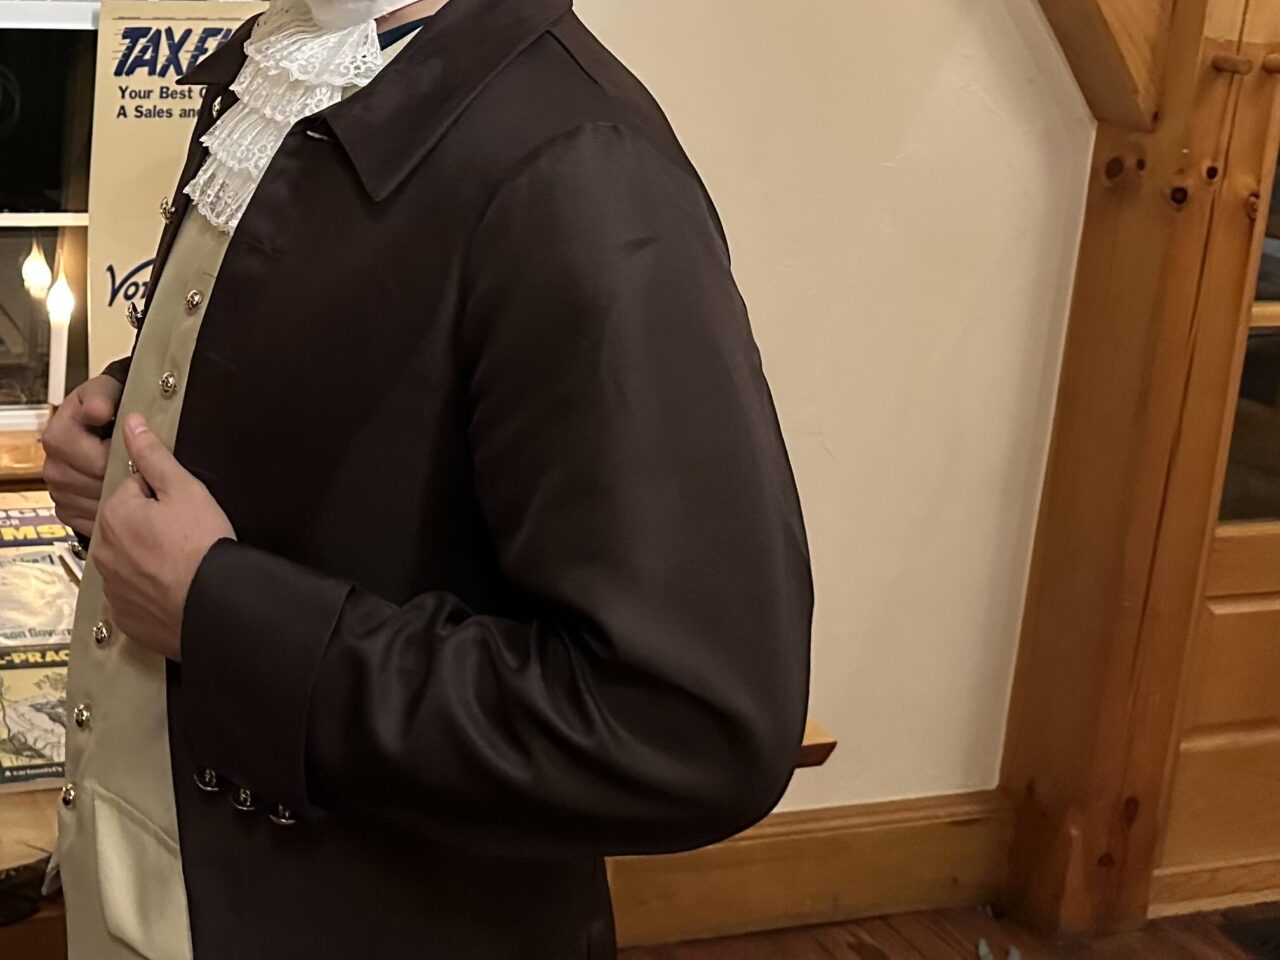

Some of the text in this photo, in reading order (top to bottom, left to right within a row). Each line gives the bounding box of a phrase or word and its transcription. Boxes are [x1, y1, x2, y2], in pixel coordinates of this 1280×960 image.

[118, 86, 153, 99] Your
[159, 86, 193, 99] Best
[116, 105, 128, 118] A
[134, 105, 173, 118] Sales
